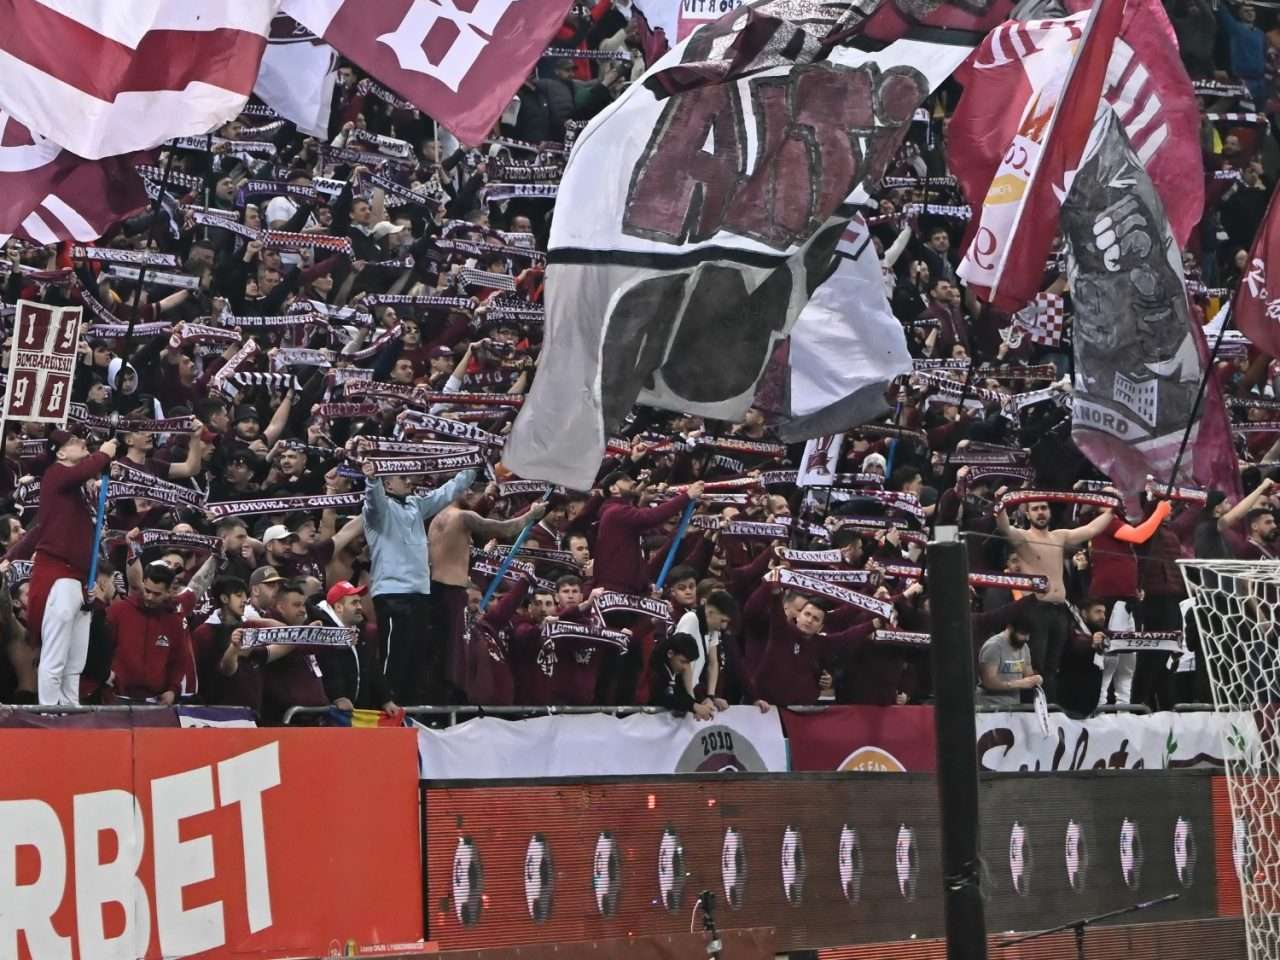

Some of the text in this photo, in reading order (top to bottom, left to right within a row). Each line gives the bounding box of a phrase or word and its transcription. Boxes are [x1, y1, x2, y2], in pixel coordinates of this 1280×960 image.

[24, 312, 37, 345] 1
[463, 373, 503, 384] APID
[47, 380, 64, 413] 8
[1080, 406, 1129, 435] NORD
[700, 731, 735, 751] 2010
